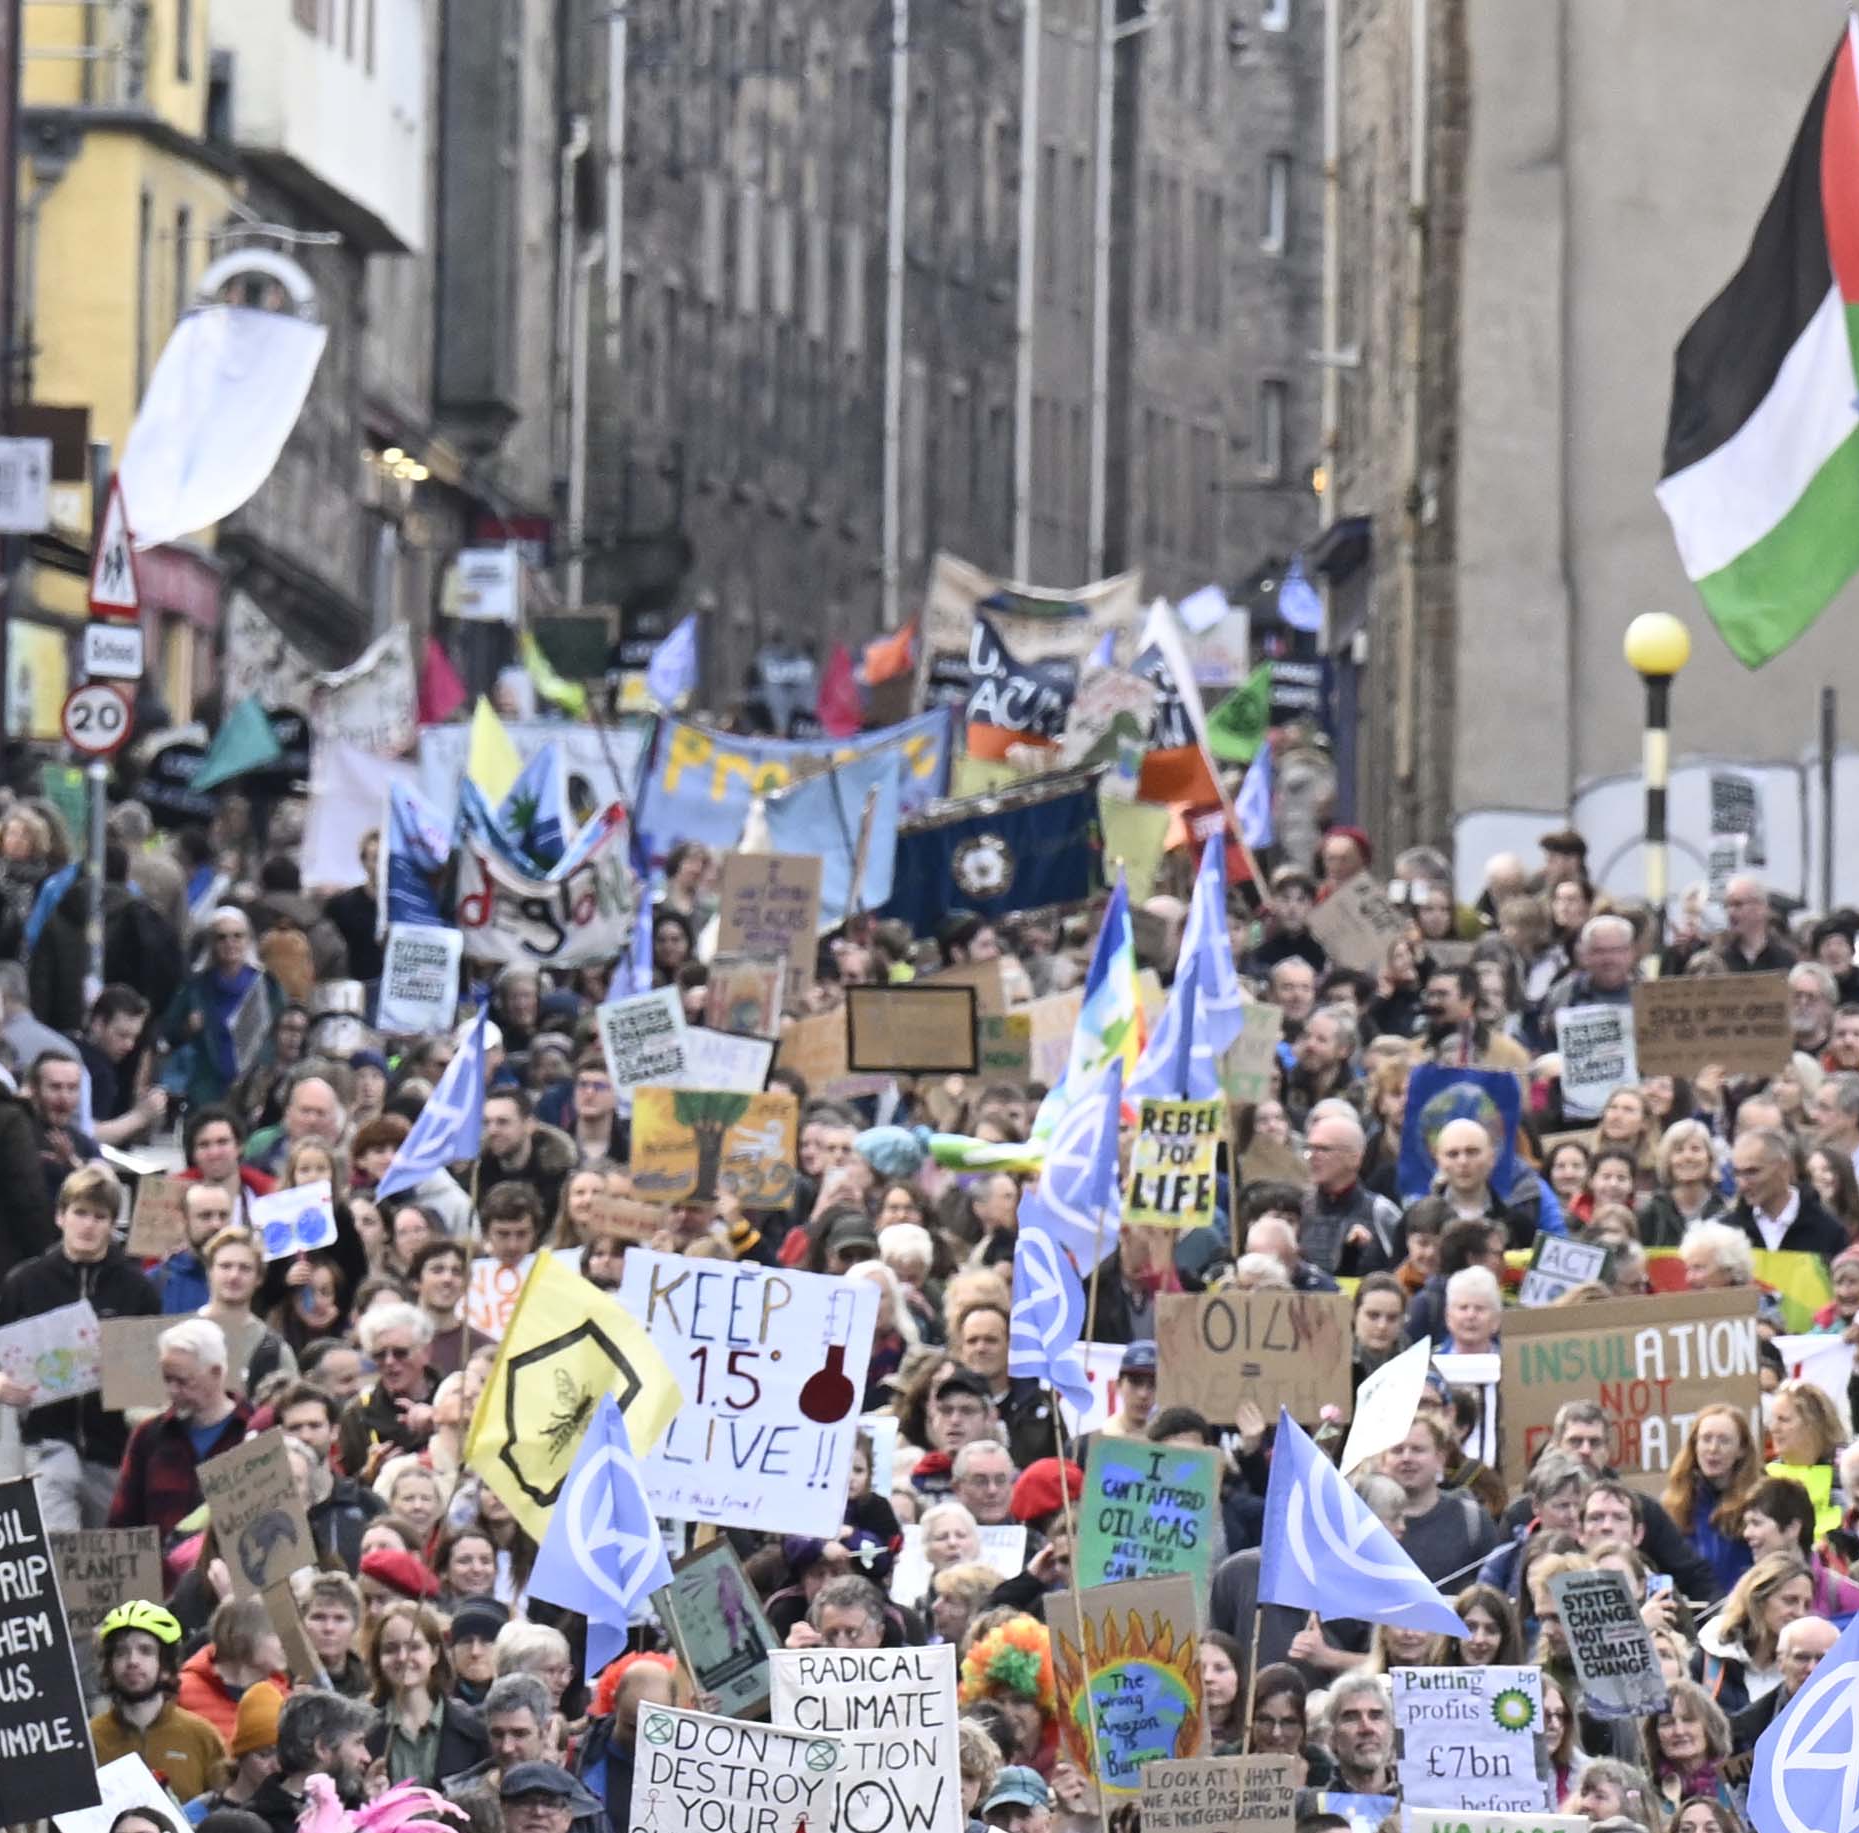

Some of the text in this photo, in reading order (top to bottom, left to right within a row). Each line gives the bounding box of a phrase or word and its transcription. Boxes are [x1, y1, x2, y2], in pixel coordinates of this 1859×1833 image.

[72, 704, 120, 731] 20
[1142, 1107, 1216, 1135] REBEL
[1131, 1173, 1210, 1212] LIFE
[1547, 1249, 1599, 1276] ACT
[646, 1263, 792, 1345] KEEP
[1520, 1317, 1758, 1385] INSULATION
[1600, 1379, 1674, 1417] NOT
[64, 1554, 139, 1580] PLANET
[799, 1655, 933, 1684] RADICAL
[1110, 1673, 1145, 1690] The
[1404, 1670, 1484, 1696] Putting
[795, 1691, 944, 1731] CLIMATE
[1408, 1700, 1480, 1725] profits
[675, 1718, 799, 1767] DON'T
[1425, 1746, 1511, 1779] £7bn
[651, 1753, 824, 1807] DESTROY
